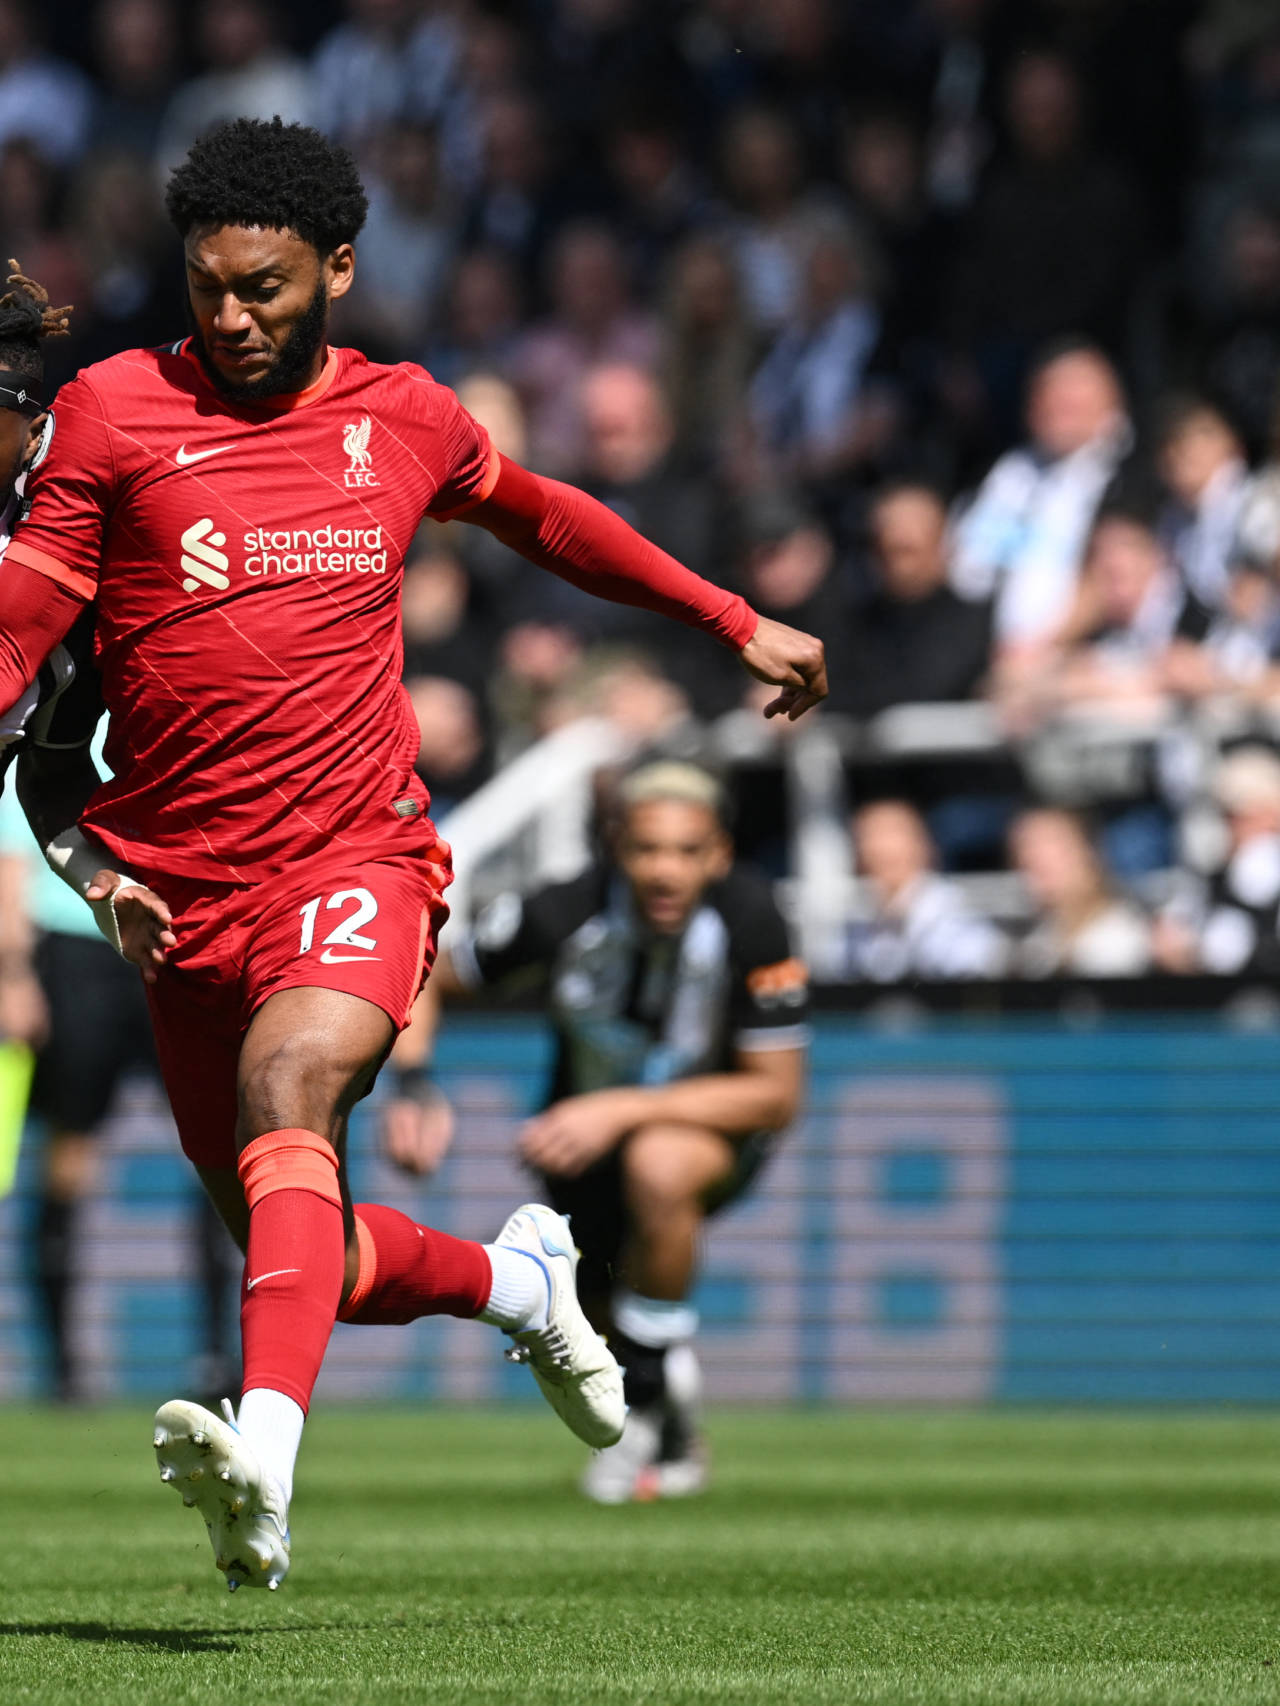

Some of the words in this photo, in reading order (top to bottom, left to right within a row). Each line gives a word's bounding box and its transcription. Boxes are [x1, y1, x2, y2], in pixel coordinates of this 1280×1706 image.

[243, 524, 382, 551] standard
[244, 548, 387, 576] chartered
[299, 887, 378, 955] 12
